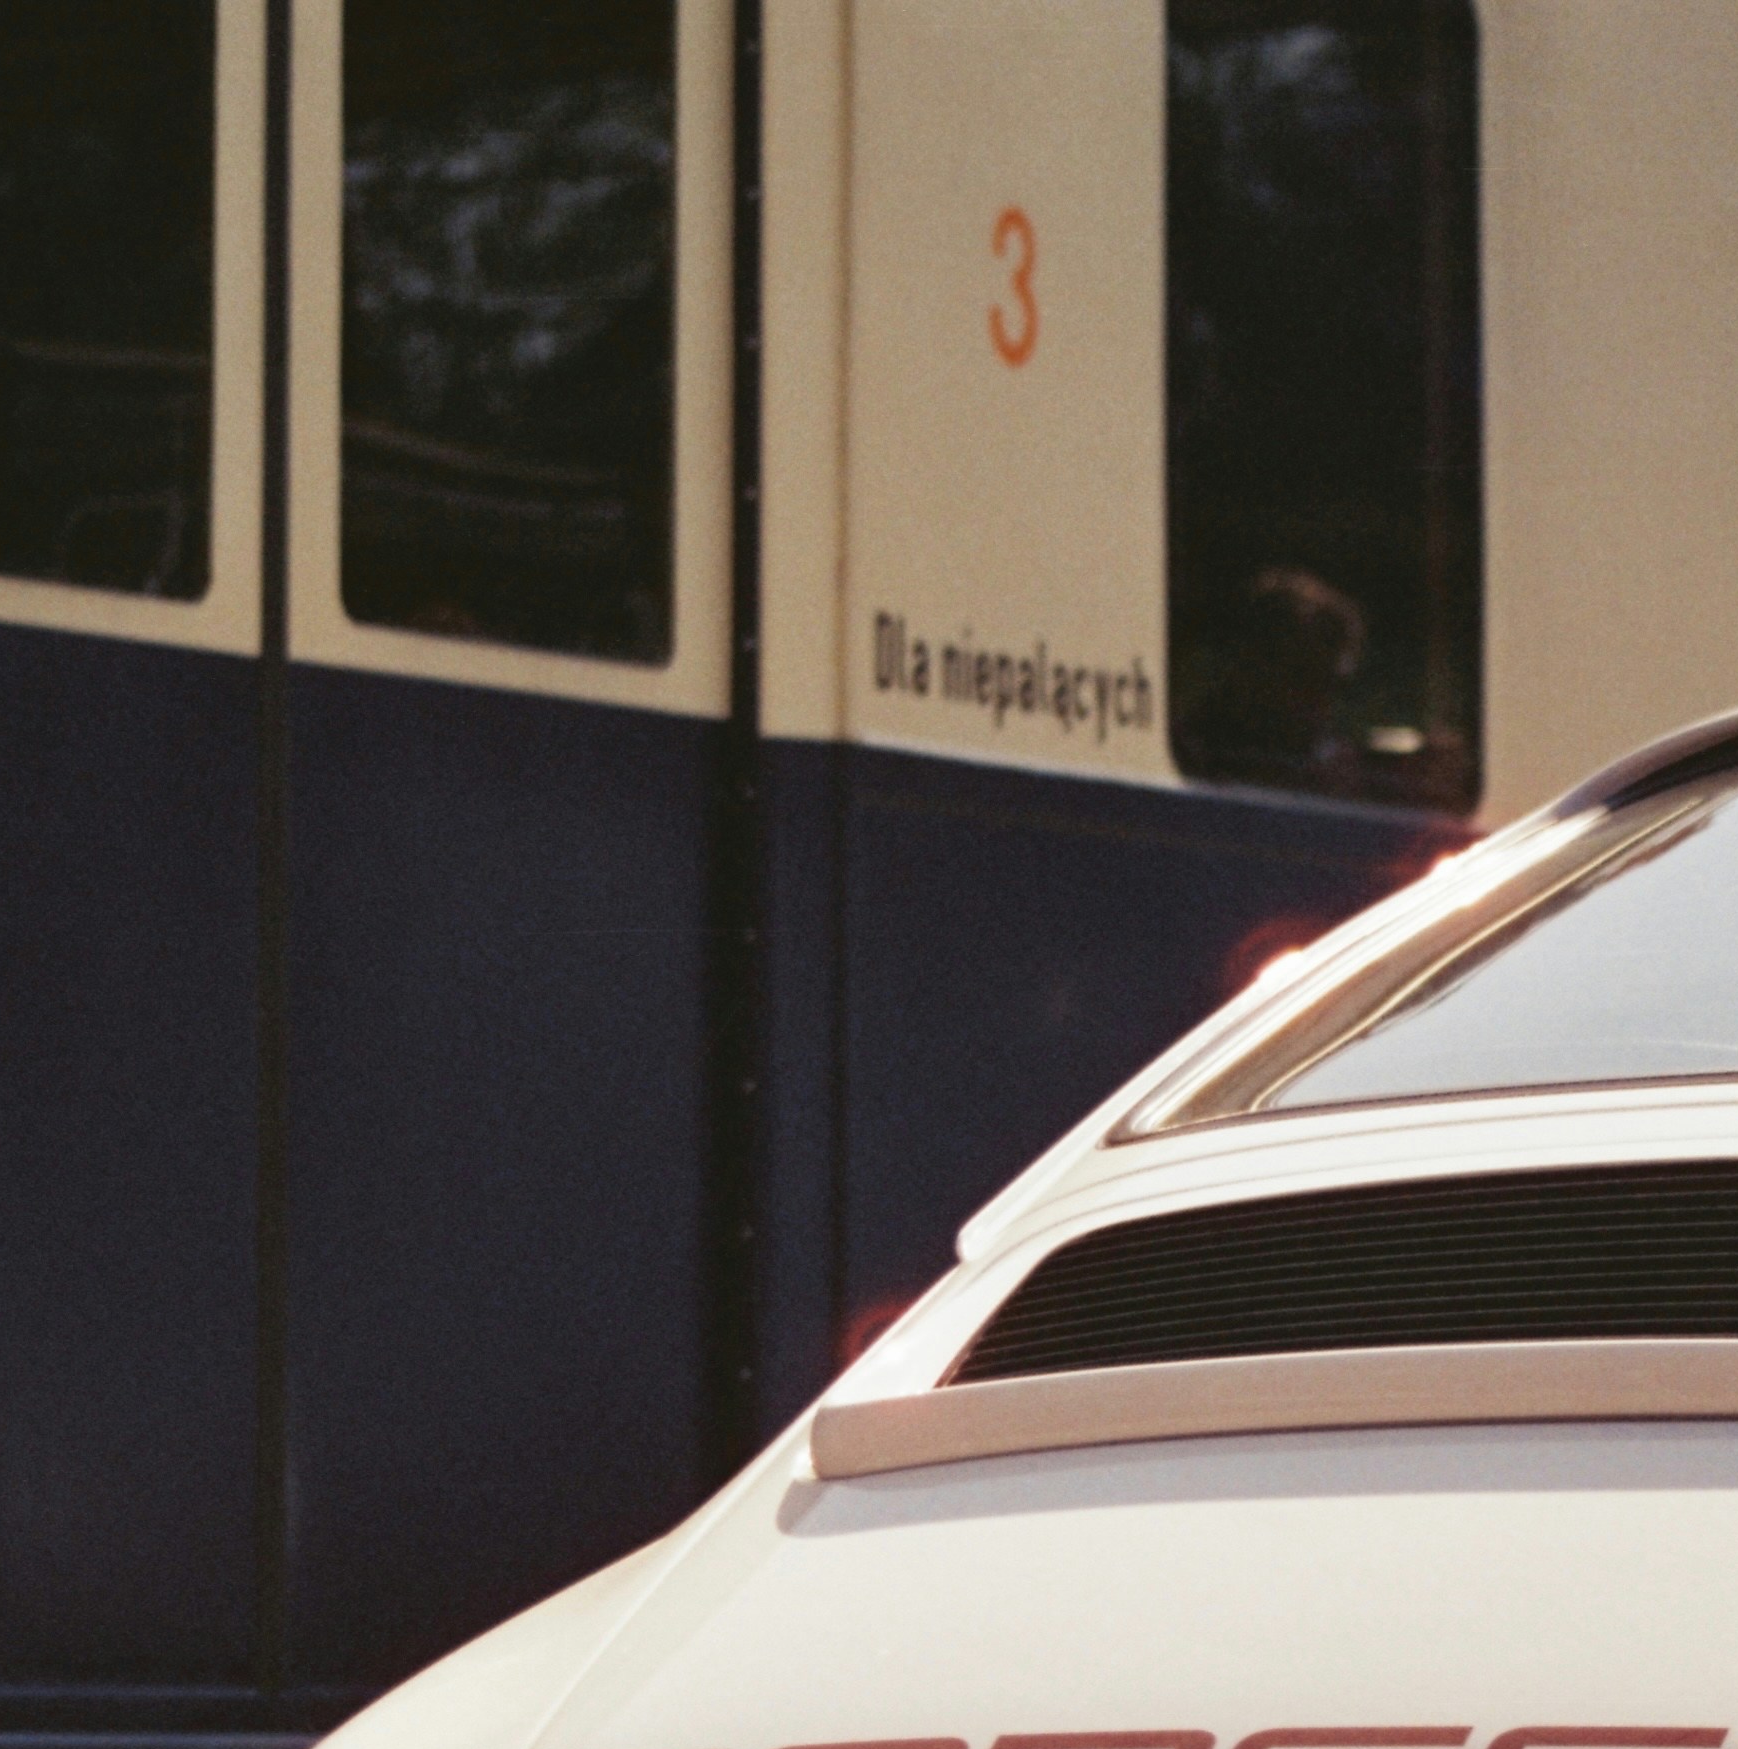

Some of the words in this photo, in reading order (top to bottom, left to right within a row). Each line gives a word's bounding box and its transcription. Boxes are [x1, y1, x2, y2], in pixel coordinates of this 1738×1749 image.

[987, 205, 1040, 370] 3
[873, 608, 932, 699] Dla
[941, 625, 1154, 743] niepalących
